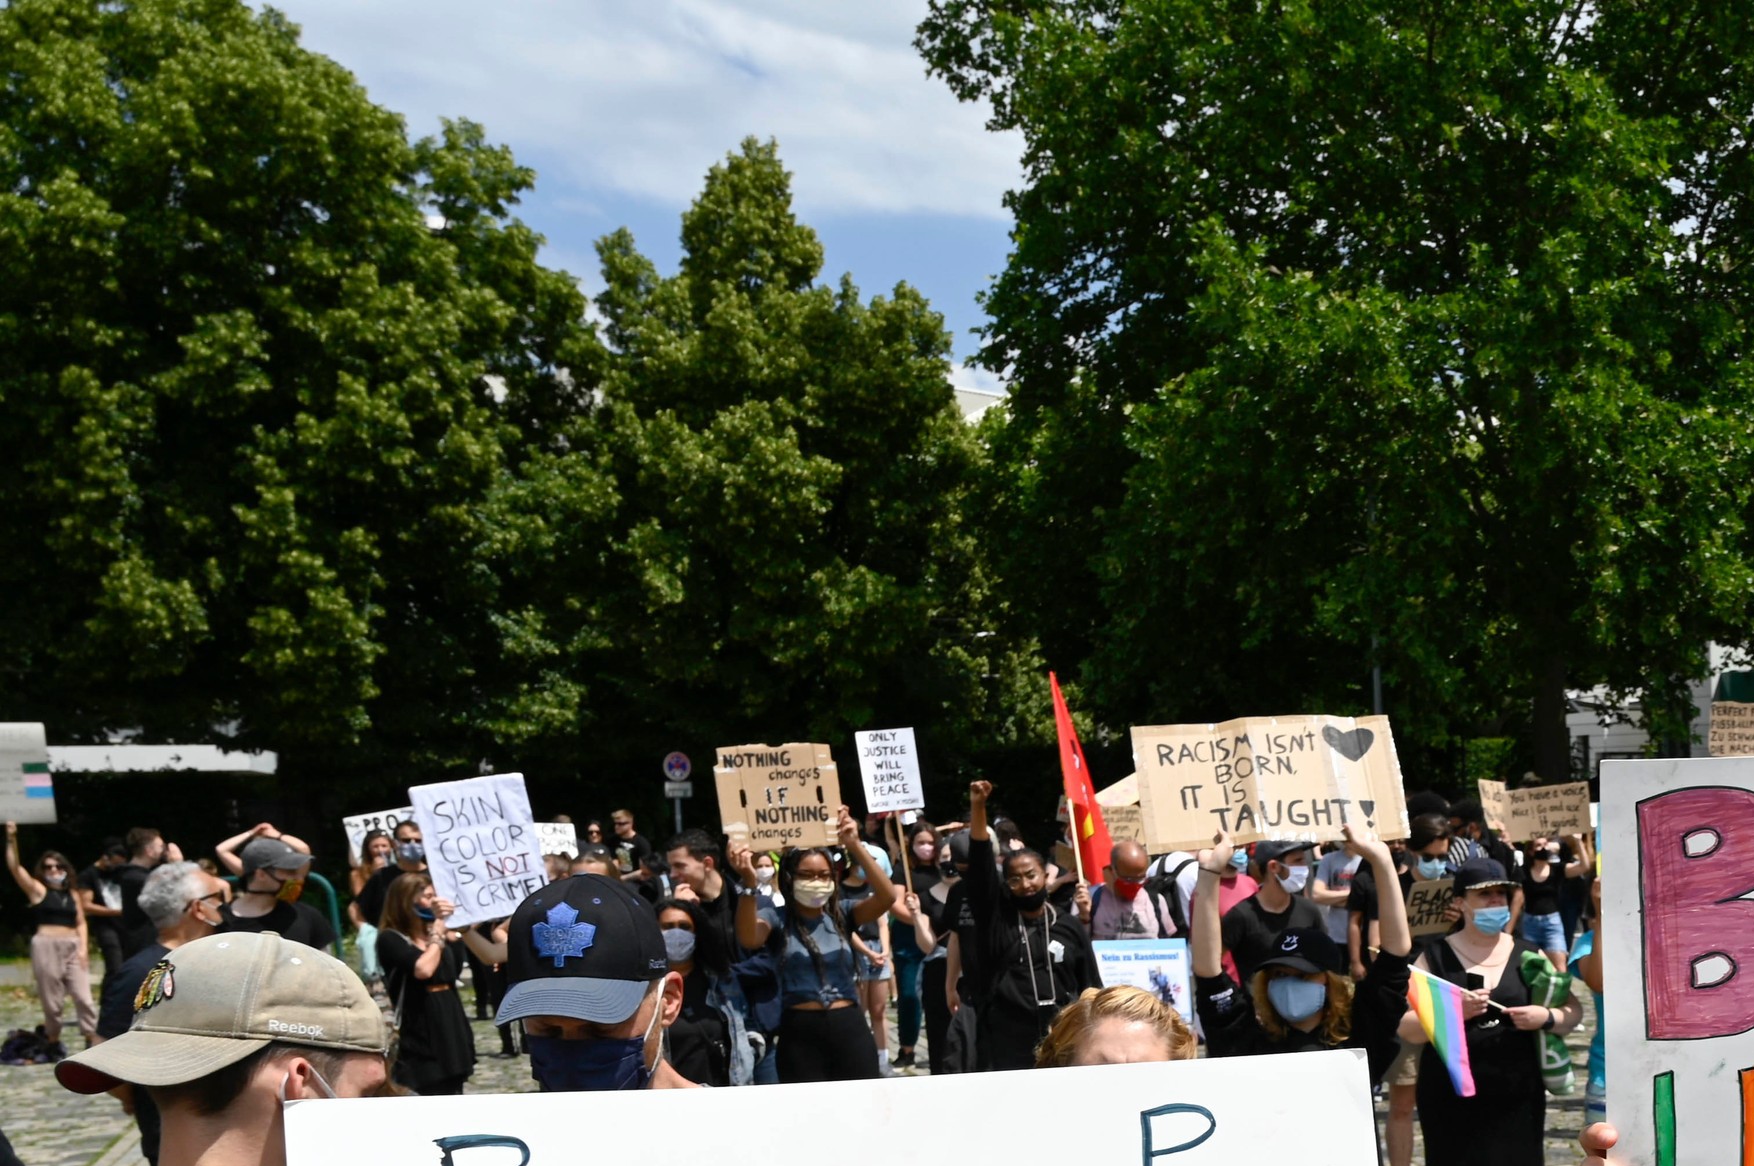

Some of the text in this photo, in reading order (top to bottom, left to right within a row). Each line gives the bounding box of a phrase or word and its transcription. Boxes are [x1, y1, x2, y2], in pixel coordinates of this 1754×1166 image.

[1711, 704, 1748, 716] PERFEKT
[868, 731, 897, 742] ONLY
[1711, 731, 1725, 742] ZU
[864, 745, 907, 757] JUSTICE
[1156, 733, 1254, 767] RACISM
[1711, 745, 1725, 755] DIE
[722, 751, 791, 768] NOTHING
[874, 760, 902, 770] WILL
[768, 767, 821, 786] changes
[873, 772, 905, 784] BRING
[1214, 756, 1298, 785] BORN,
[765, 786, 788, 805] IF
[872, 783, 910, 797] PEACE
[1180, 780, 1247, 810] IT IS
[433, 791, 506, 835] SKIN
[755, 806, 829, 824] NOTHING
[439, 824, 527, 864] COLOR
[751, 827, 802, 845] changes
[453, 852, 531, 887] IS NOT
[454, 874, 546, 914] A CRIME!
[1101, 952, 1180, 962] Nein zu Rassismus!
[268, 1019, 324, 1036] Reebok
